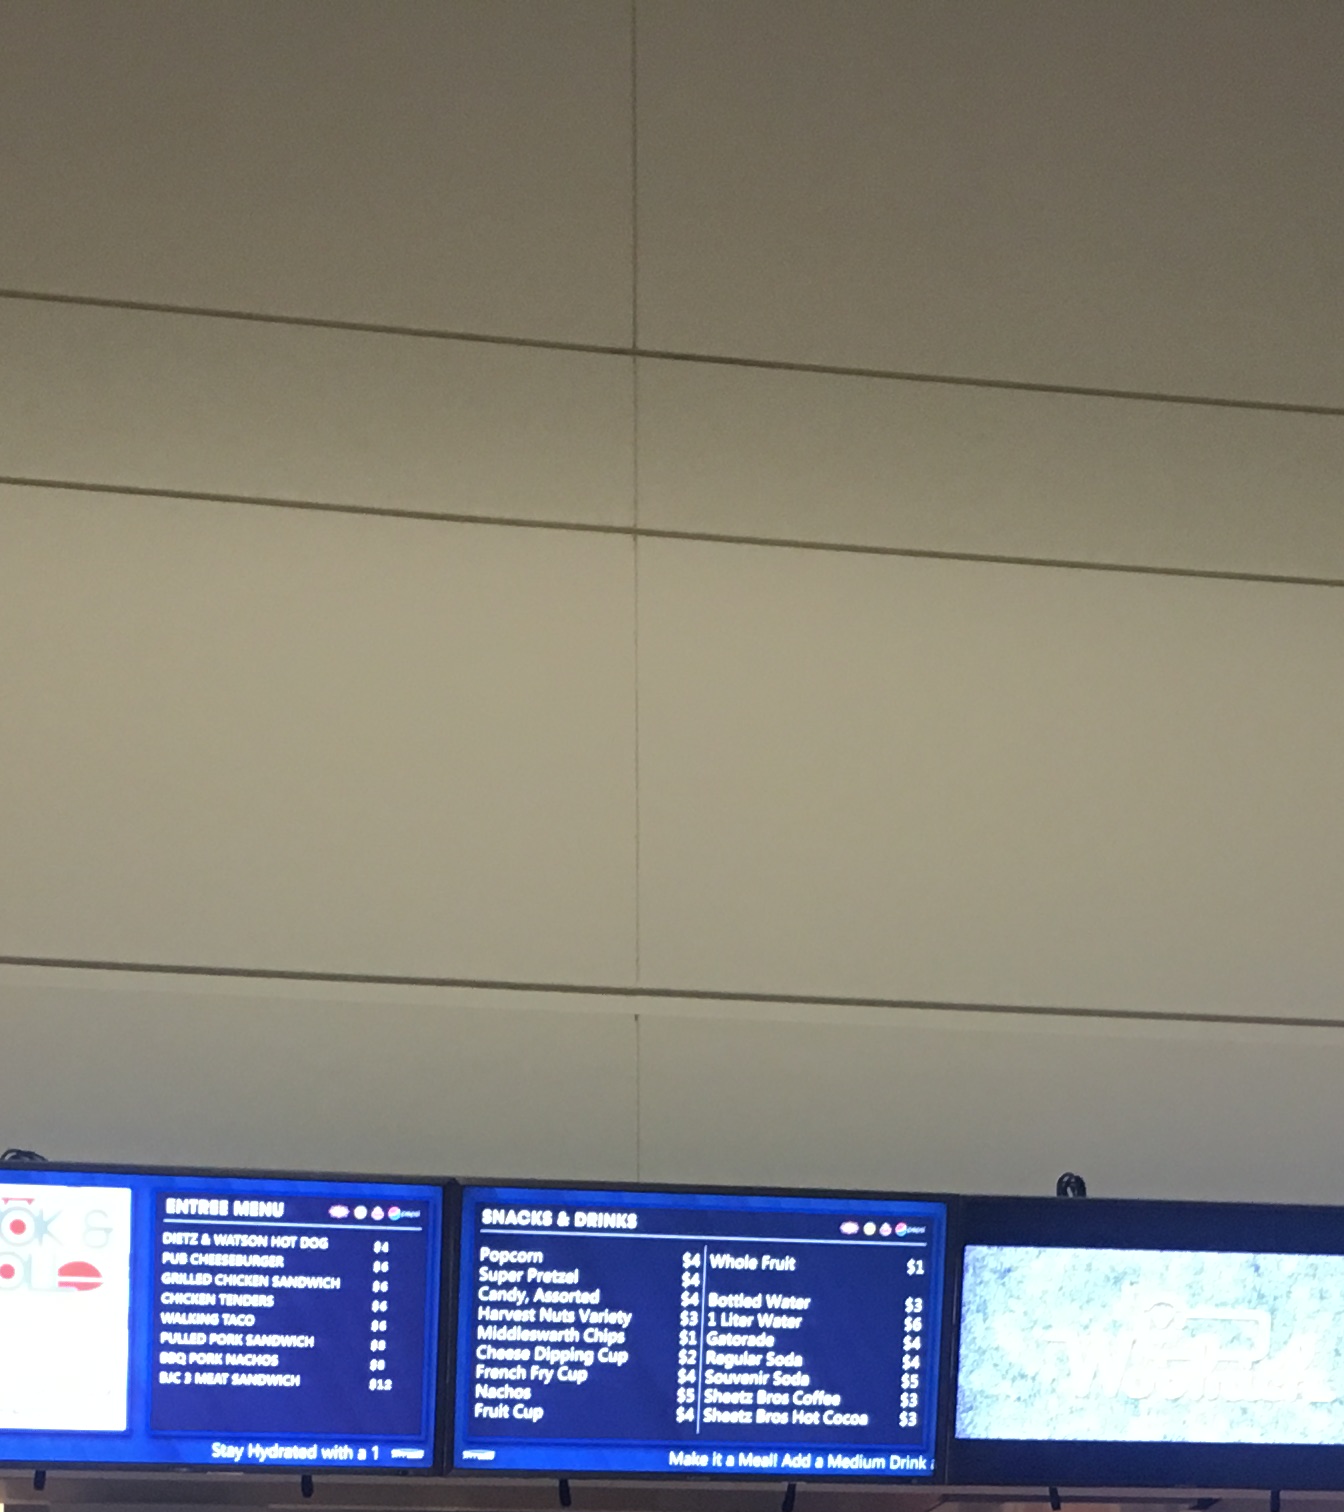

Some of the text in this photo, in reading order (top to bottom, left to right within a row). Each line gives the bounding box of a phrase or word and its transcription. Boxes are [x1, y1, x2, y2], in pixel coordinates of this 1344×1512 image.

[165, 1197, 284, 1217] ENTREE MENU
[481, 1208, 637, 1229] SNACKS & DRINKS
[162, 1231, 328, 1249] DIETZ & WATSON HOT DOG
[161, 1251, 284, 1268] PUB CHEESEBURGER
[479, 1246, 543, 1266] Popcorn
[682, 1251, 700, 1268] $4
[709, 1253, 796, 1270] Whole Fruit
[478, 1265, 578, 1285] Super Pretzel
[906, 1258, 924, 1275] $1
[160, 1271, 340, 1289] GRILLED CHICKEN SANDWICH
[681, 1271, 700, 1288] $4
[160, 1291, 274, 1307] CHICKEN TENDERS
[477, 1285, 600, 1305] Candy, Assorted
[680, 1290, 699, 1307] $4
[708, 1291, 811, 1310] Bottled Water
[904, 1296, 922, 1313] $3
[159, 1311, 255, 1326] WALKING TACO
[477, 1305, 632, 1328] Harvest Nuts Variety
[679, 1310, 698, 1327] $3
[707, 1311, 802, 1328] 1 Liter Water
[904, 1315, 922, 1332] $6
[159, 1331, 314, 1347] PULLED PORK SANDWICH
[477, 1324, 625, 1346] Middleswarth Chips
[678, 1329, 697, 1346] $1
[705, 1330, 774, 1347] Gatorade
[902, 1334, 921, 1351] $4
[188, 1351, 223, 1365] PORK
[225, 1352, 278, 1366] NACHOS
[475, 1344, 628, 1366] Cheese Dipping Cup
[678, 1348, 697, 1365] $2
[705, 1349, 802, 1369] Regular Soda
[902, 1353, 920, 1370] $4
[194, 1371, 229, 1384] MEAT
[230, 1372, 300, 1386] SANDWICH
[475, 1363, 588, 1384] French Fry Cup
[677, 1368, 696, 1385] $4
[704, 1368, 810, 1386] Souvenir Soda
[900, 1373, 918, 1389] $5
[475, 1383, 531, 1399] Nachos
[676, 1387, 695, 1404] $5
[703, 1387, 841, 1406] Sheetz Bros Coffee
[900, 1391, 917, 1408] $3
[474, 1402, 544, 1422] Fruit Cup
[675, 1406, 694, 1422] $4
[702, 1406, 868, 1425] Sheetz Bros Hot Cocoa
[898, 1411, 917, 1427] $3
[212, 1443, 244, 1461] Stay
[248, 1443, 317, 1462] Hydrated
[321, 1445, 353, 1459] with
[358, 1449, 366, 1460] a
[372, 1446, 378, 1460] 1
[670, 1451, 926, 1469] Make it a Meal! Add a Medium Drink
